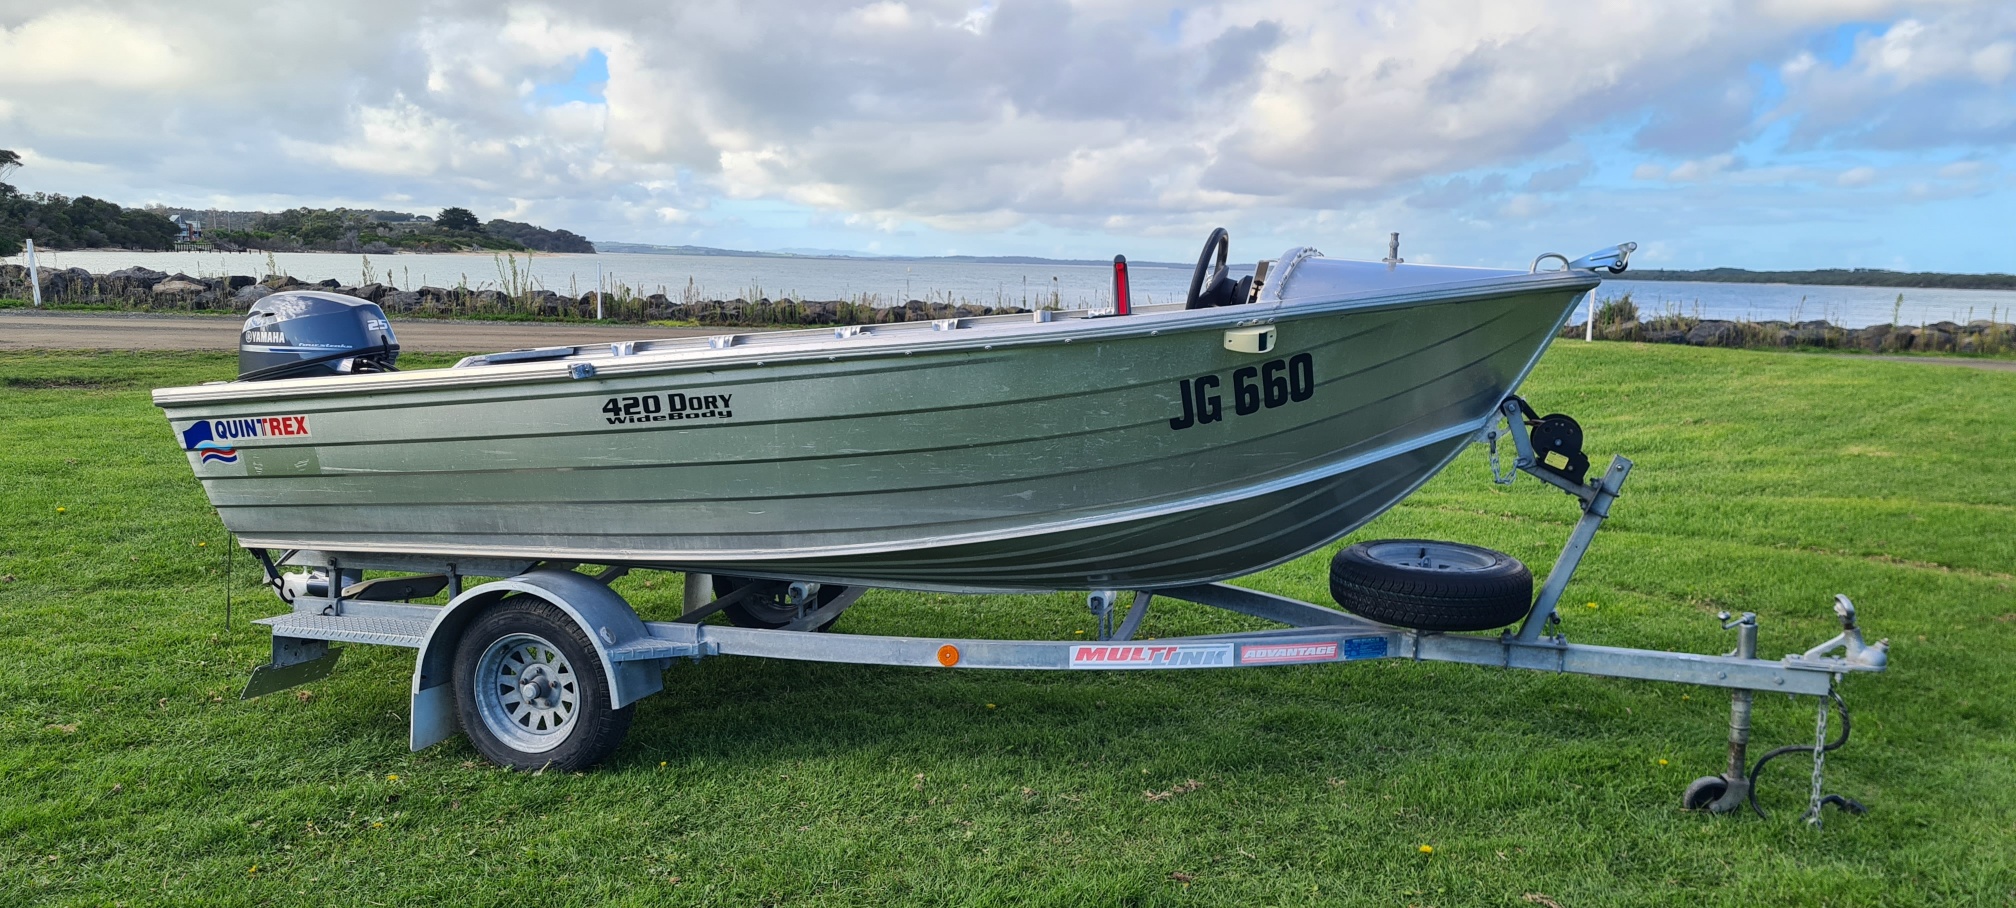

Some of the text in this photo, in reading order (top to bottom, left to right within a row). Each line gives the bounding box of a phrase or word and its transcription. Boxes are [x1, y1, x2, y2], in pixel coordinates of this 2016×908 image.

[367, 319, 389, 331] 25
[252, 331, 286, 344] YAMAHA
[1169, 352, 1315, 431] JG 660
[602, 392, 733, 417] 420 DORY
[605, 409, 733, 425] WideBody
[214, 415, 309, 440] QUINTREX
[1243, 645, 1337, 659] ADVANTAGE
